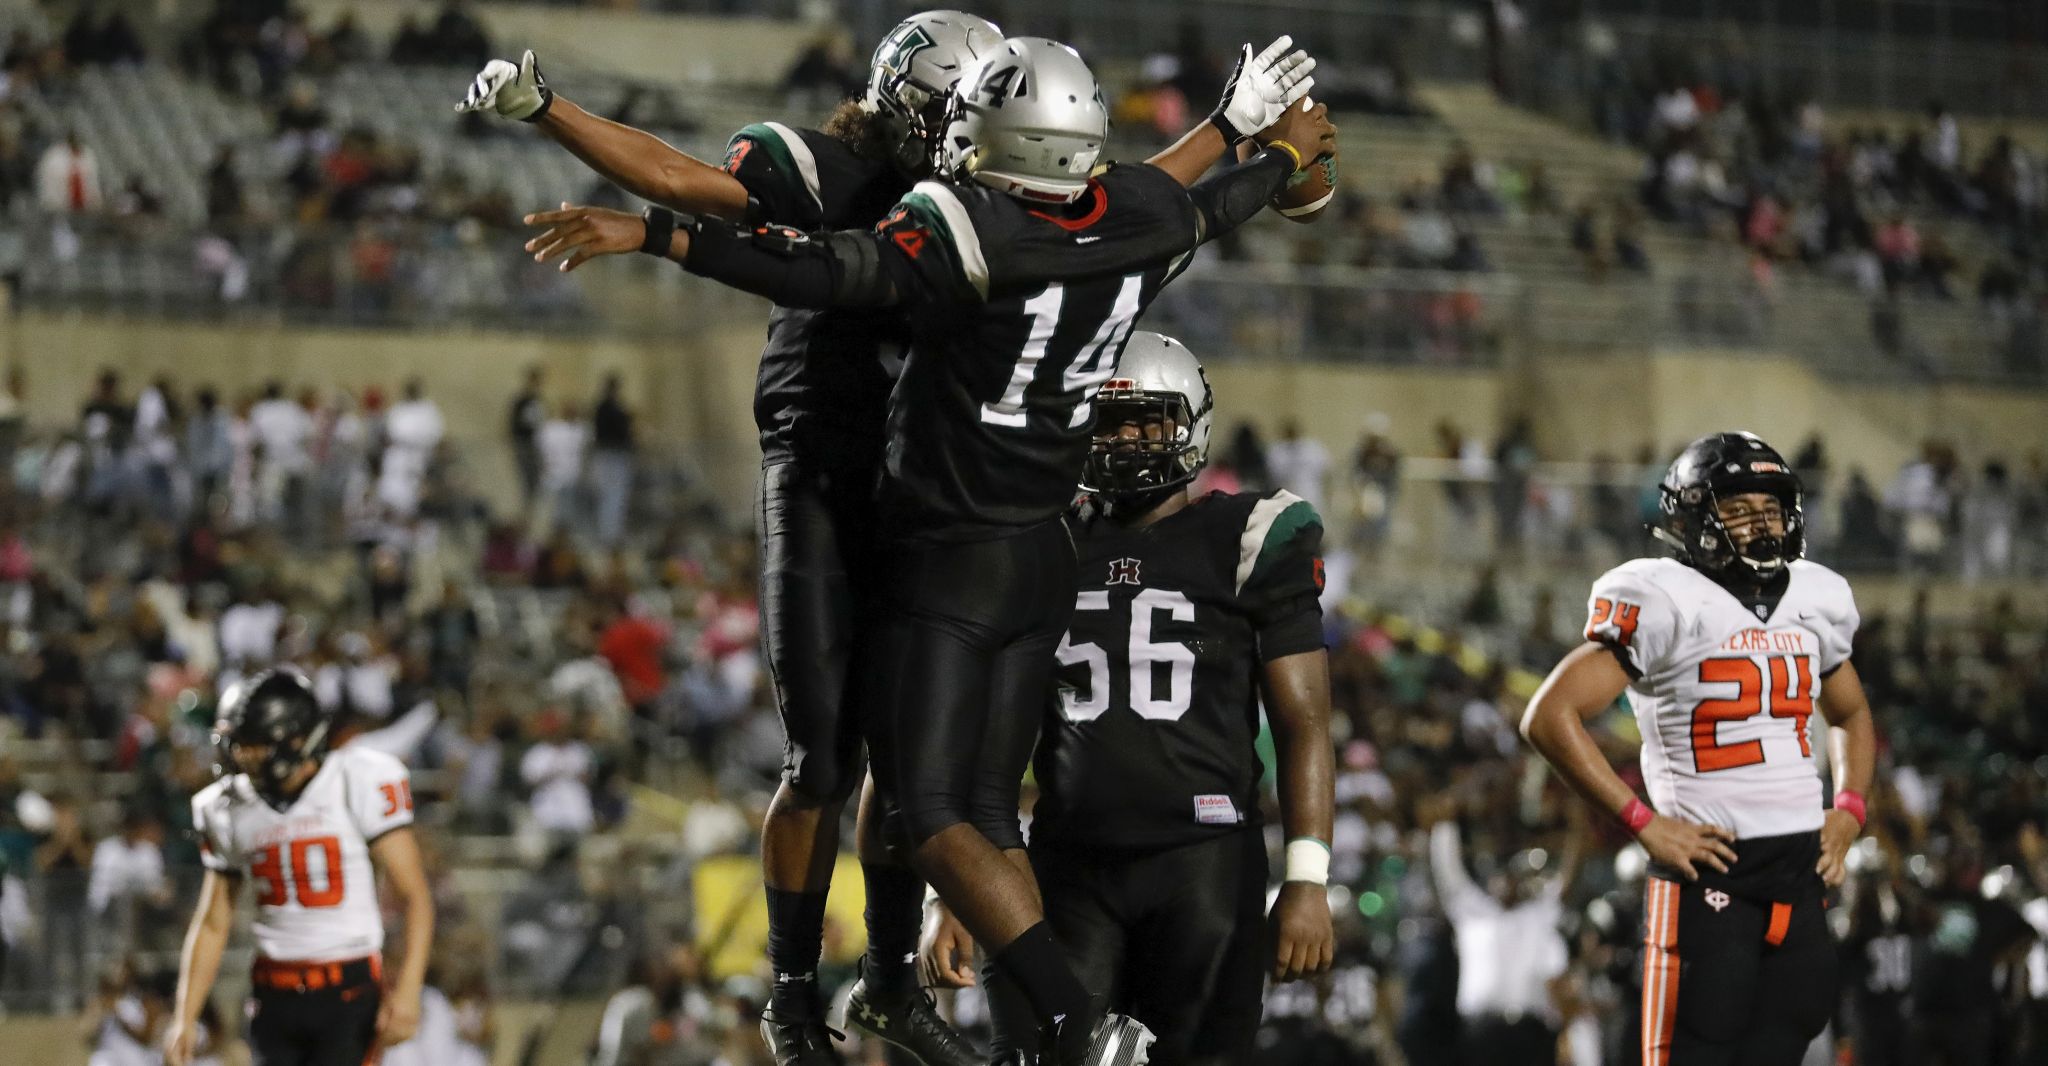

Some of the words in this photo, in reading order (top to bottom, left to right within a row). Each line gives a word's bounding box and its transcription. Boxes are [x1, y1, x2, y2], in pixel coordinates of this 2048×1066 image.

[980, 274, 1144, 428] 14
[1105, 557, 1141, 585] H
[1054, 588, 1196, 722] 56
[1587, 597, 1641, 646] 24
[1773, 632, 1804, 653] CITY
[1691, 655, 1813, 773] 24
[251, 835, 344, 908] 30
